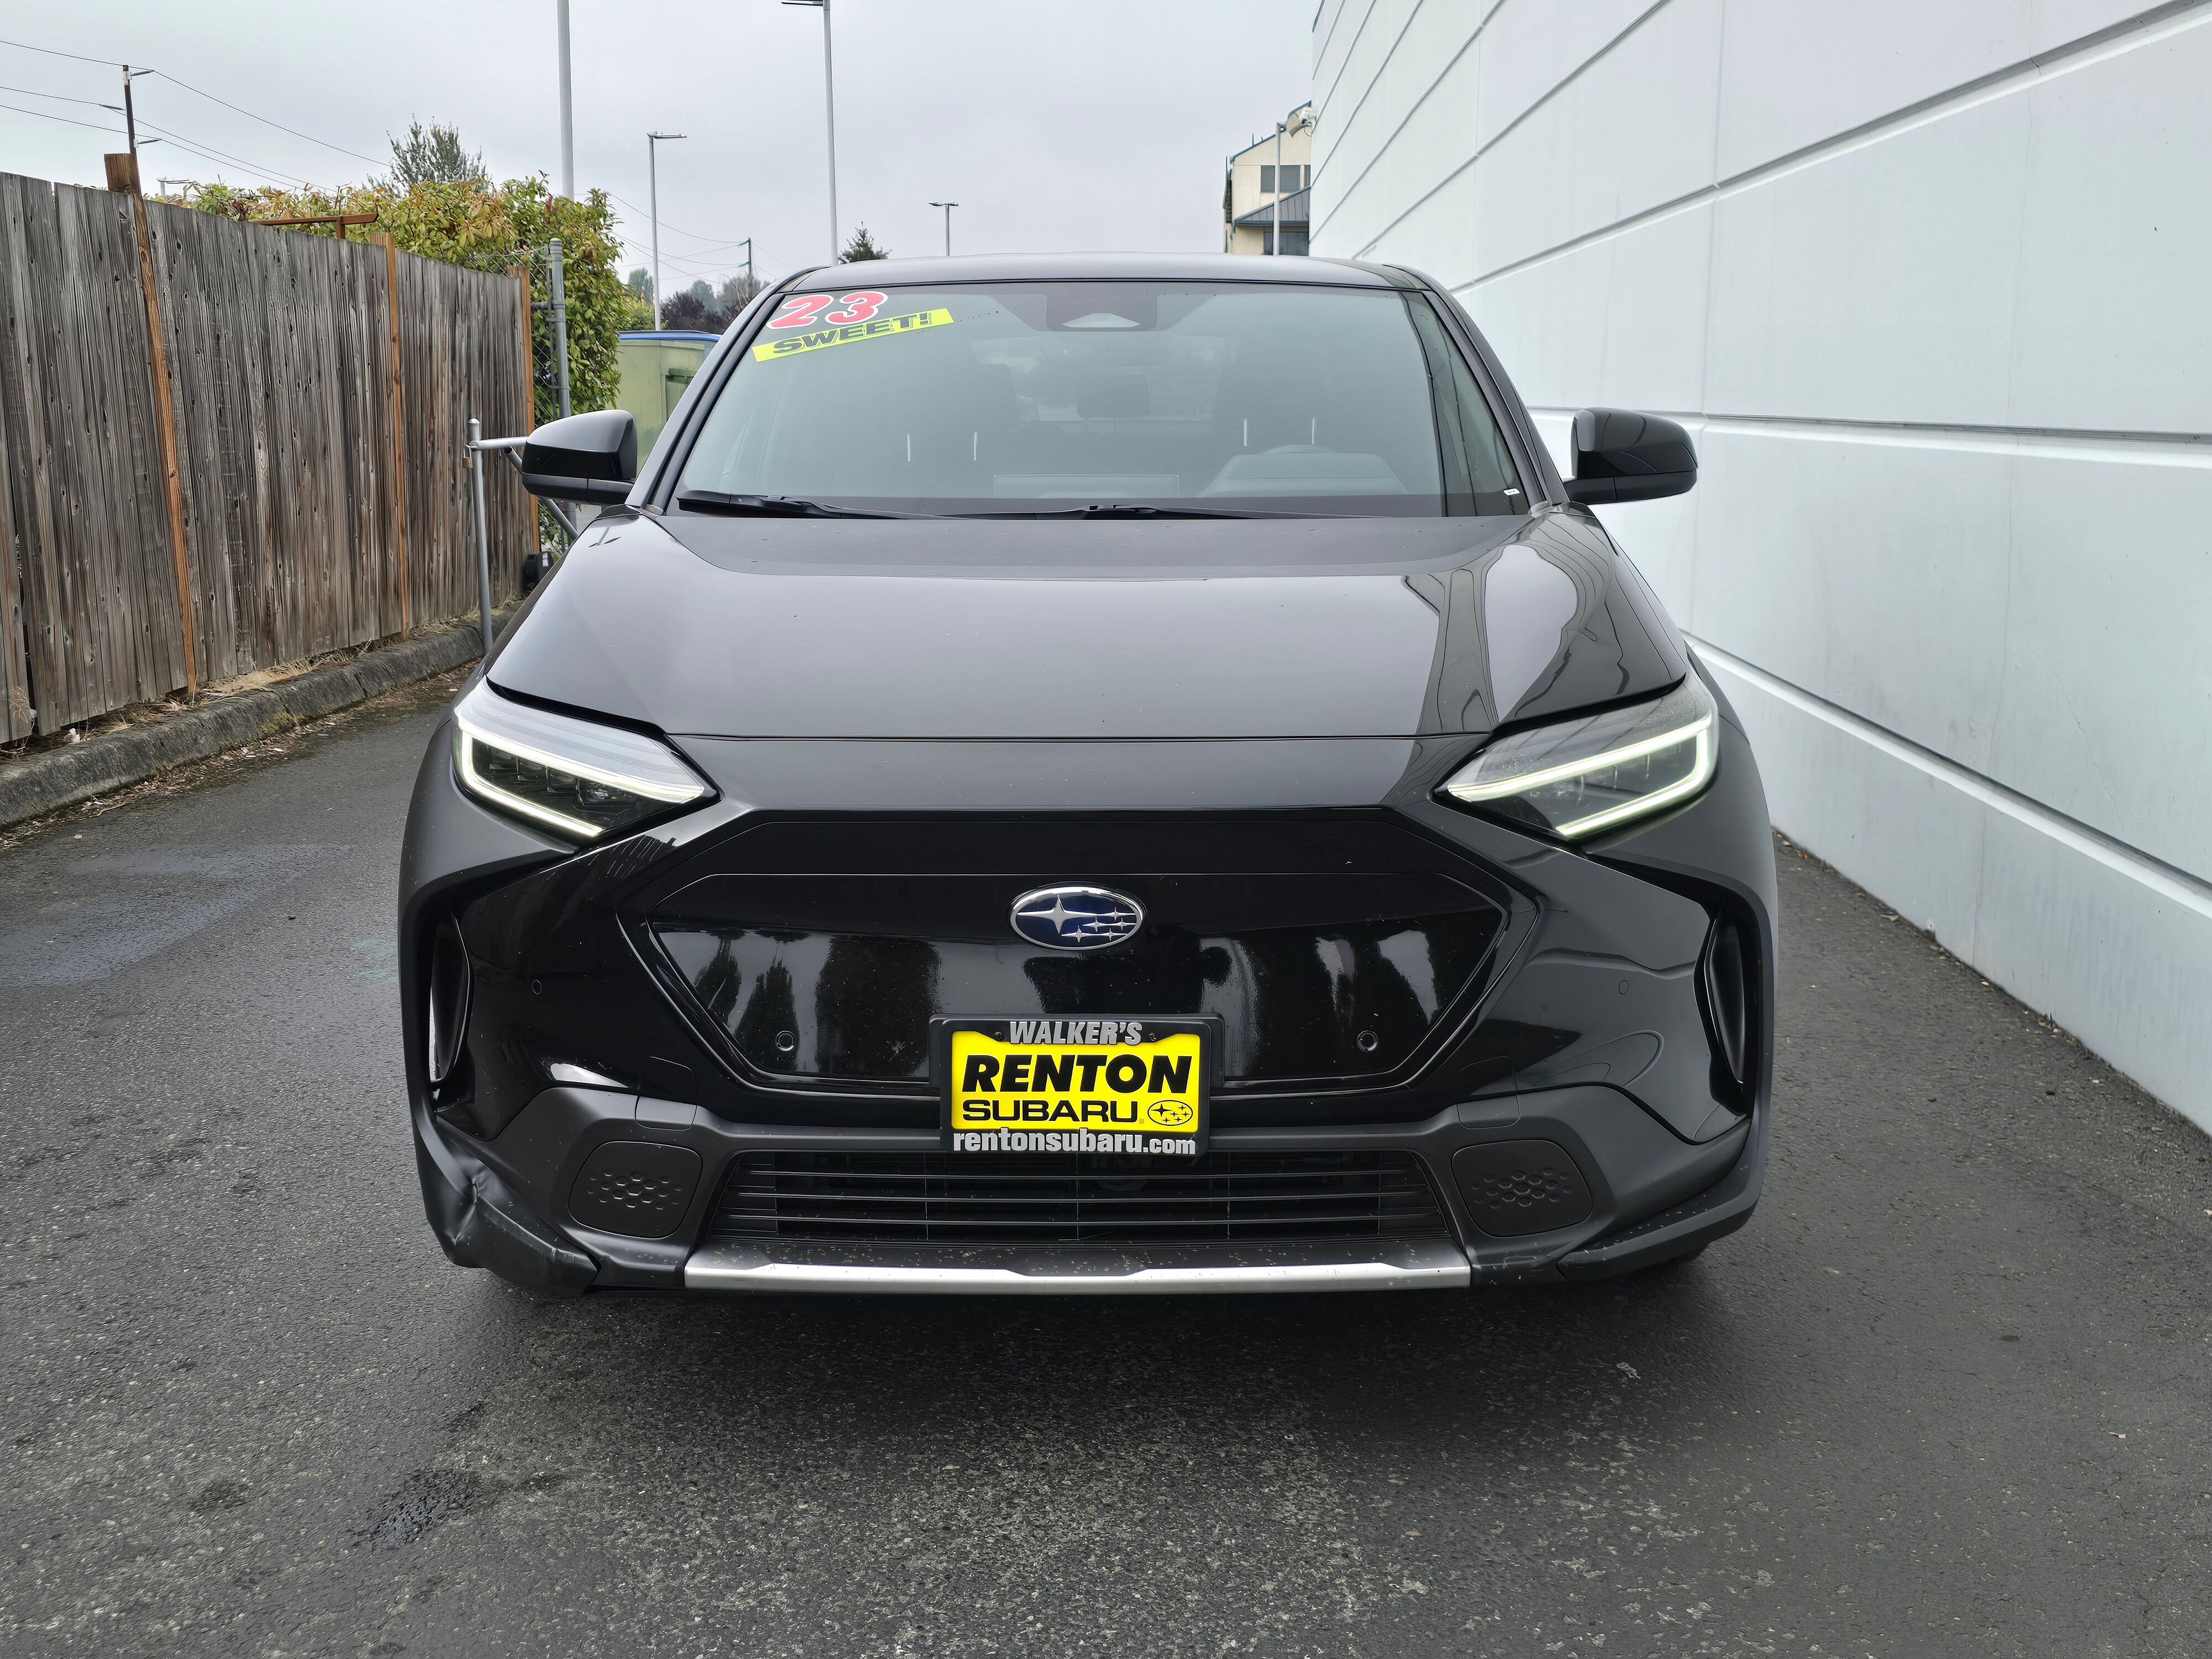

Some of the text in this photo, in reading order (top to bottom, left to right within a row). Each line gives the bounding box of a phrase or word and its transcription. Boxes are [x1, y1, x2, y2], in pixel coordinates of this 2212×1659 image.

[766, 291, 888, 329] 23
[773, 312, 932, 354] SWEET!
[1010, 1021, 1142, 1045] WALKER'S
[962, 1054, 1192, 1093] RENTON
[962, 1099, 1138, 1123] SUBARU
[953, 1127, 1196, 1155] rentonsubaru.com
